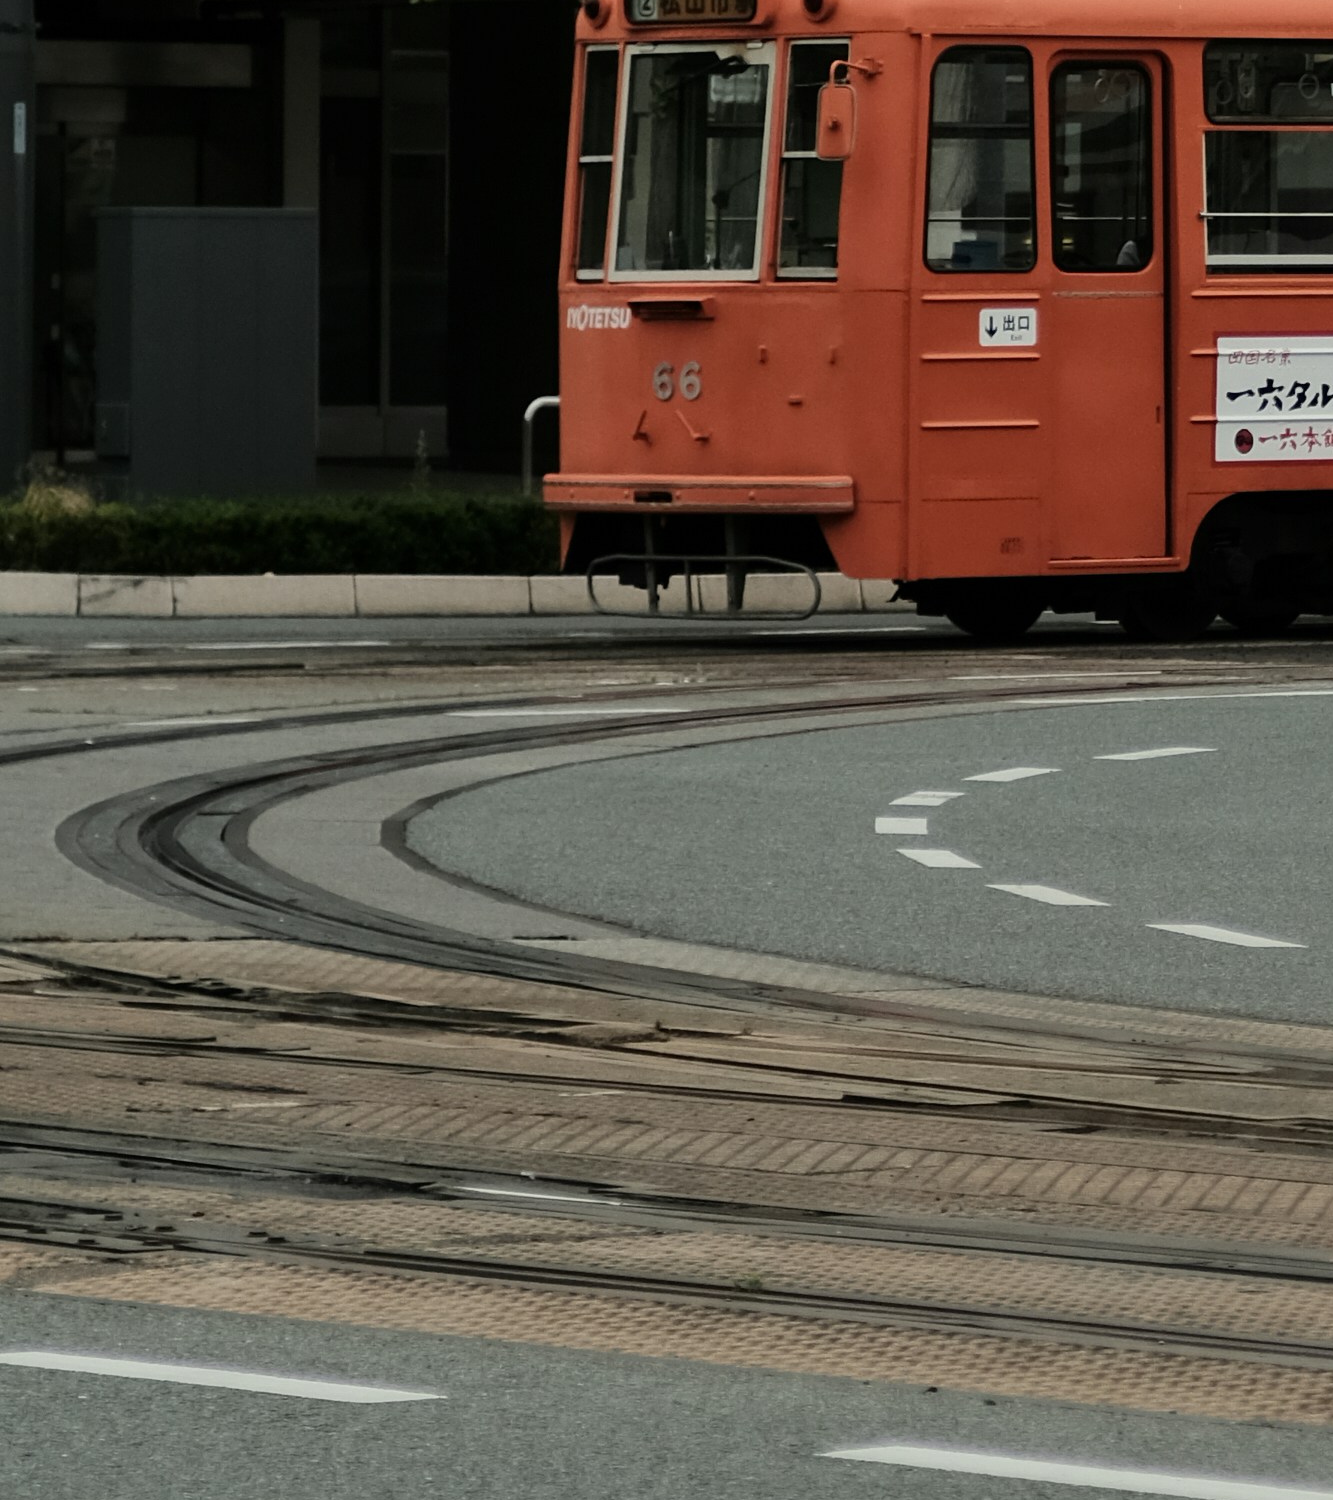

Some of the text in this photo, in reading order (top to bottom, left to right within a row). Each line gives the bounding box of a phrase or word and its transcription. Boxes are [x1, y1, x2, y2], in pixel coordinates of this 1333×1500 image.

[567, 305, 633, 331] IYOTETSU
[1003, 315, 1030, 331] 出口
[653, 361, 702, 401] 66
